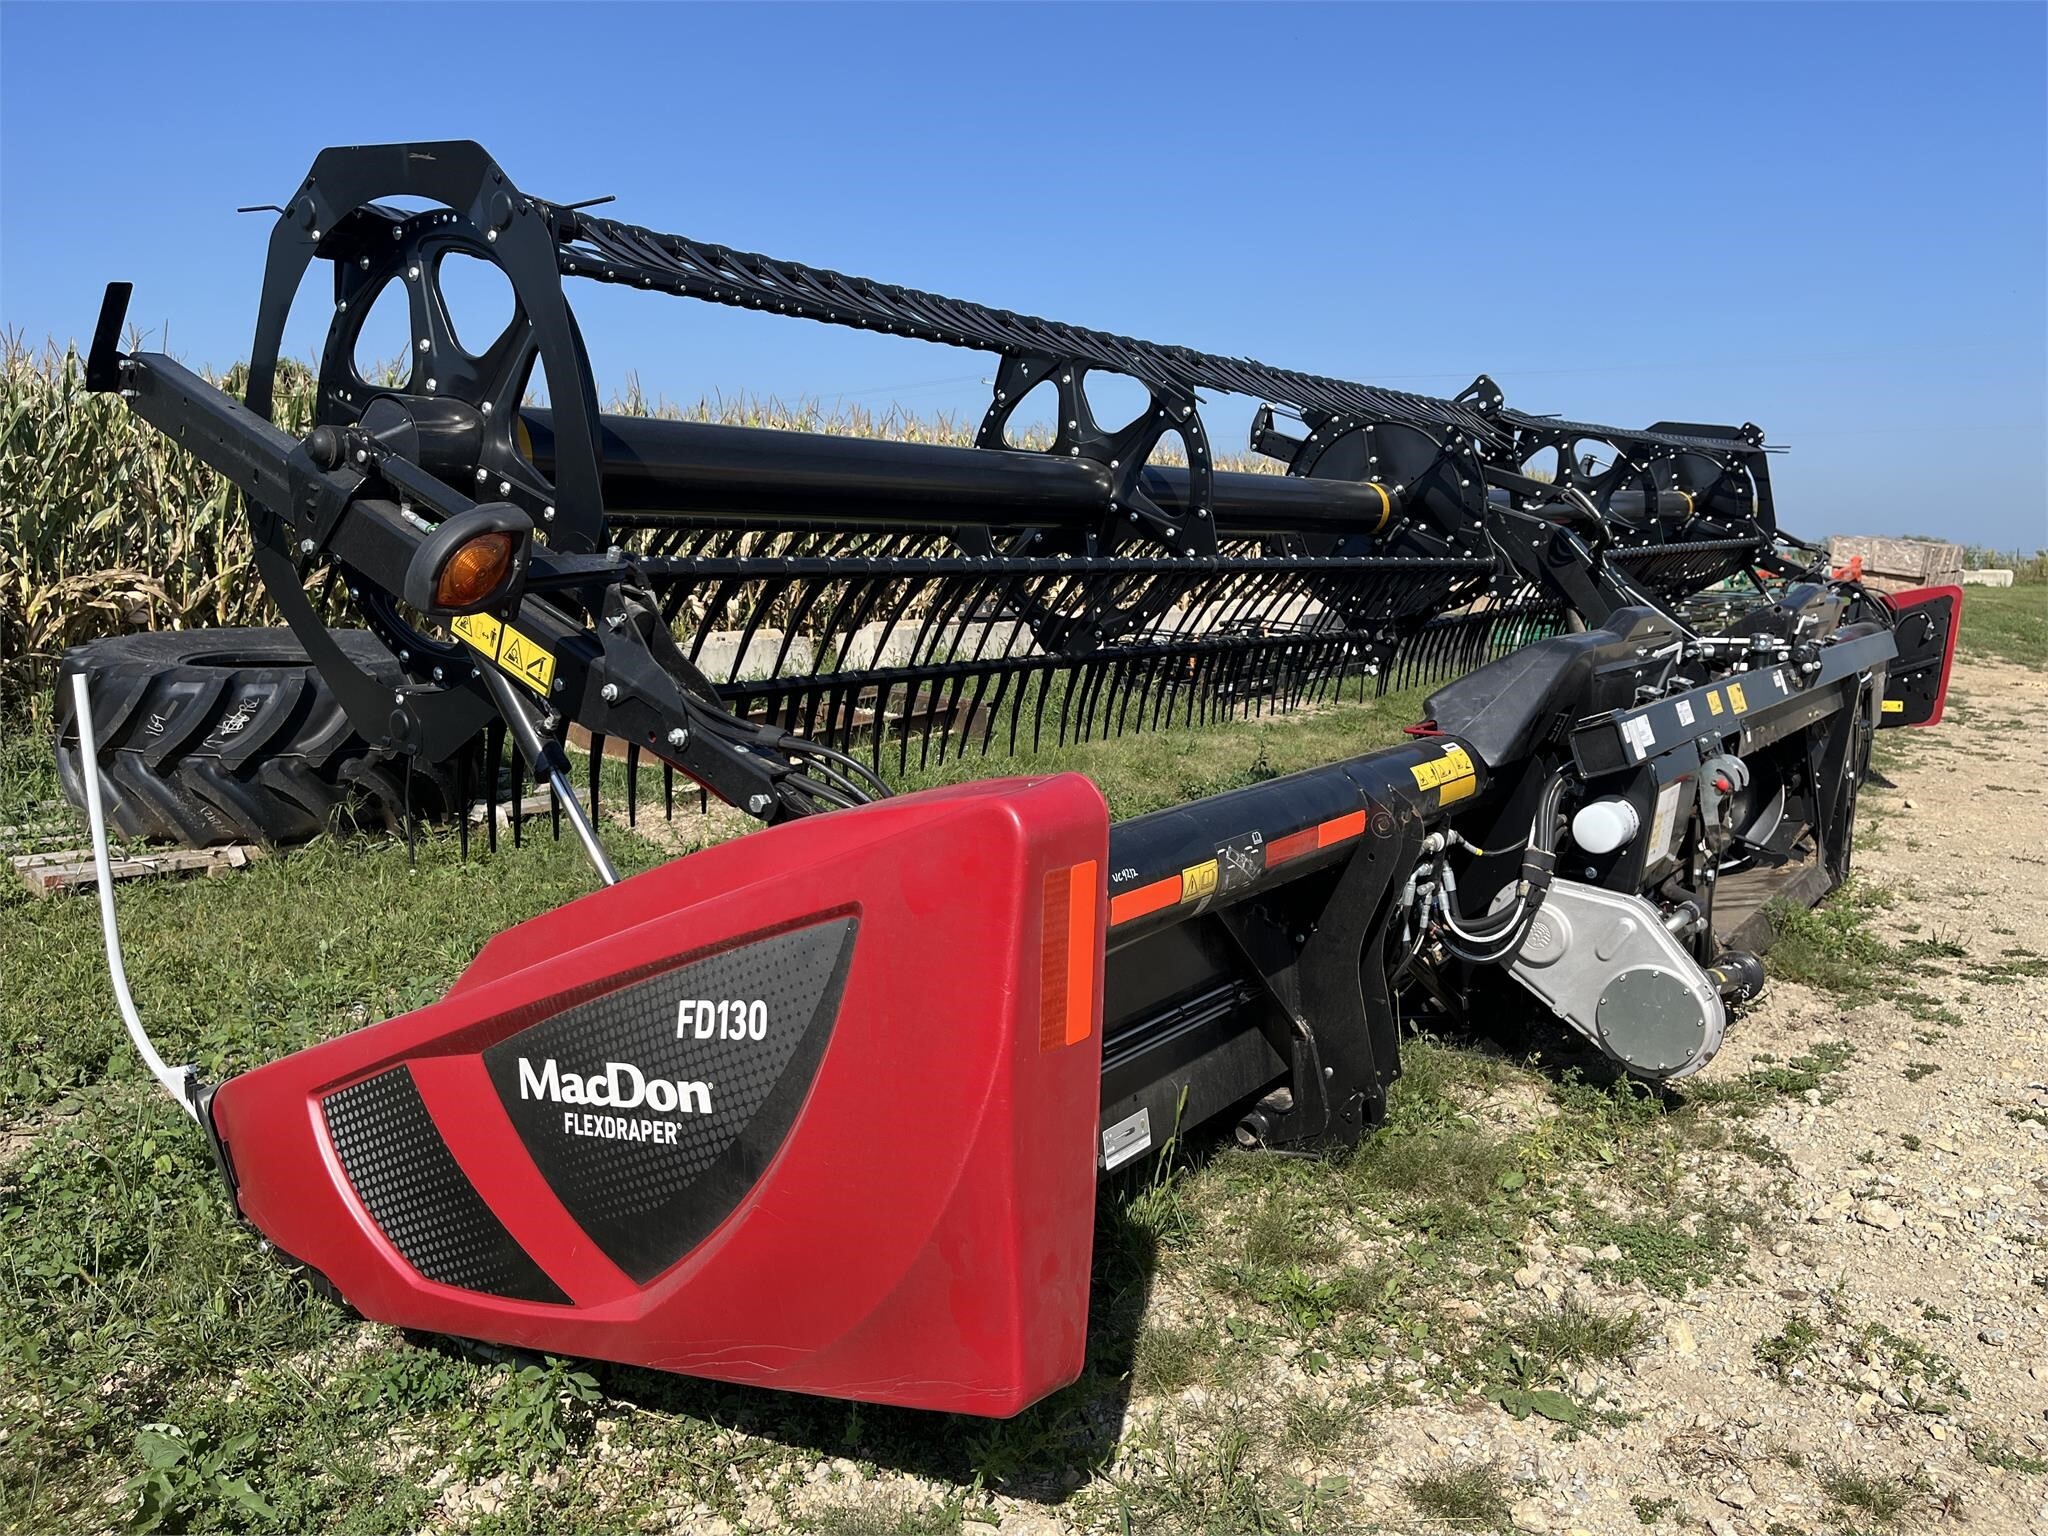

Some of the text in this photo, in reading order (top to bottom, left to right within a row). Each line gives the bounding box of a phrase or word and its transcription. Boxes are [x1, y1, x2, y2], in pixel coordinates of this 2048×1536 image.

[677, 999, 768, 1040] FD130
[518, 1057, 713, 1114] MacDon
[564, 1112, 678, 1145] FLEXDRAPER
